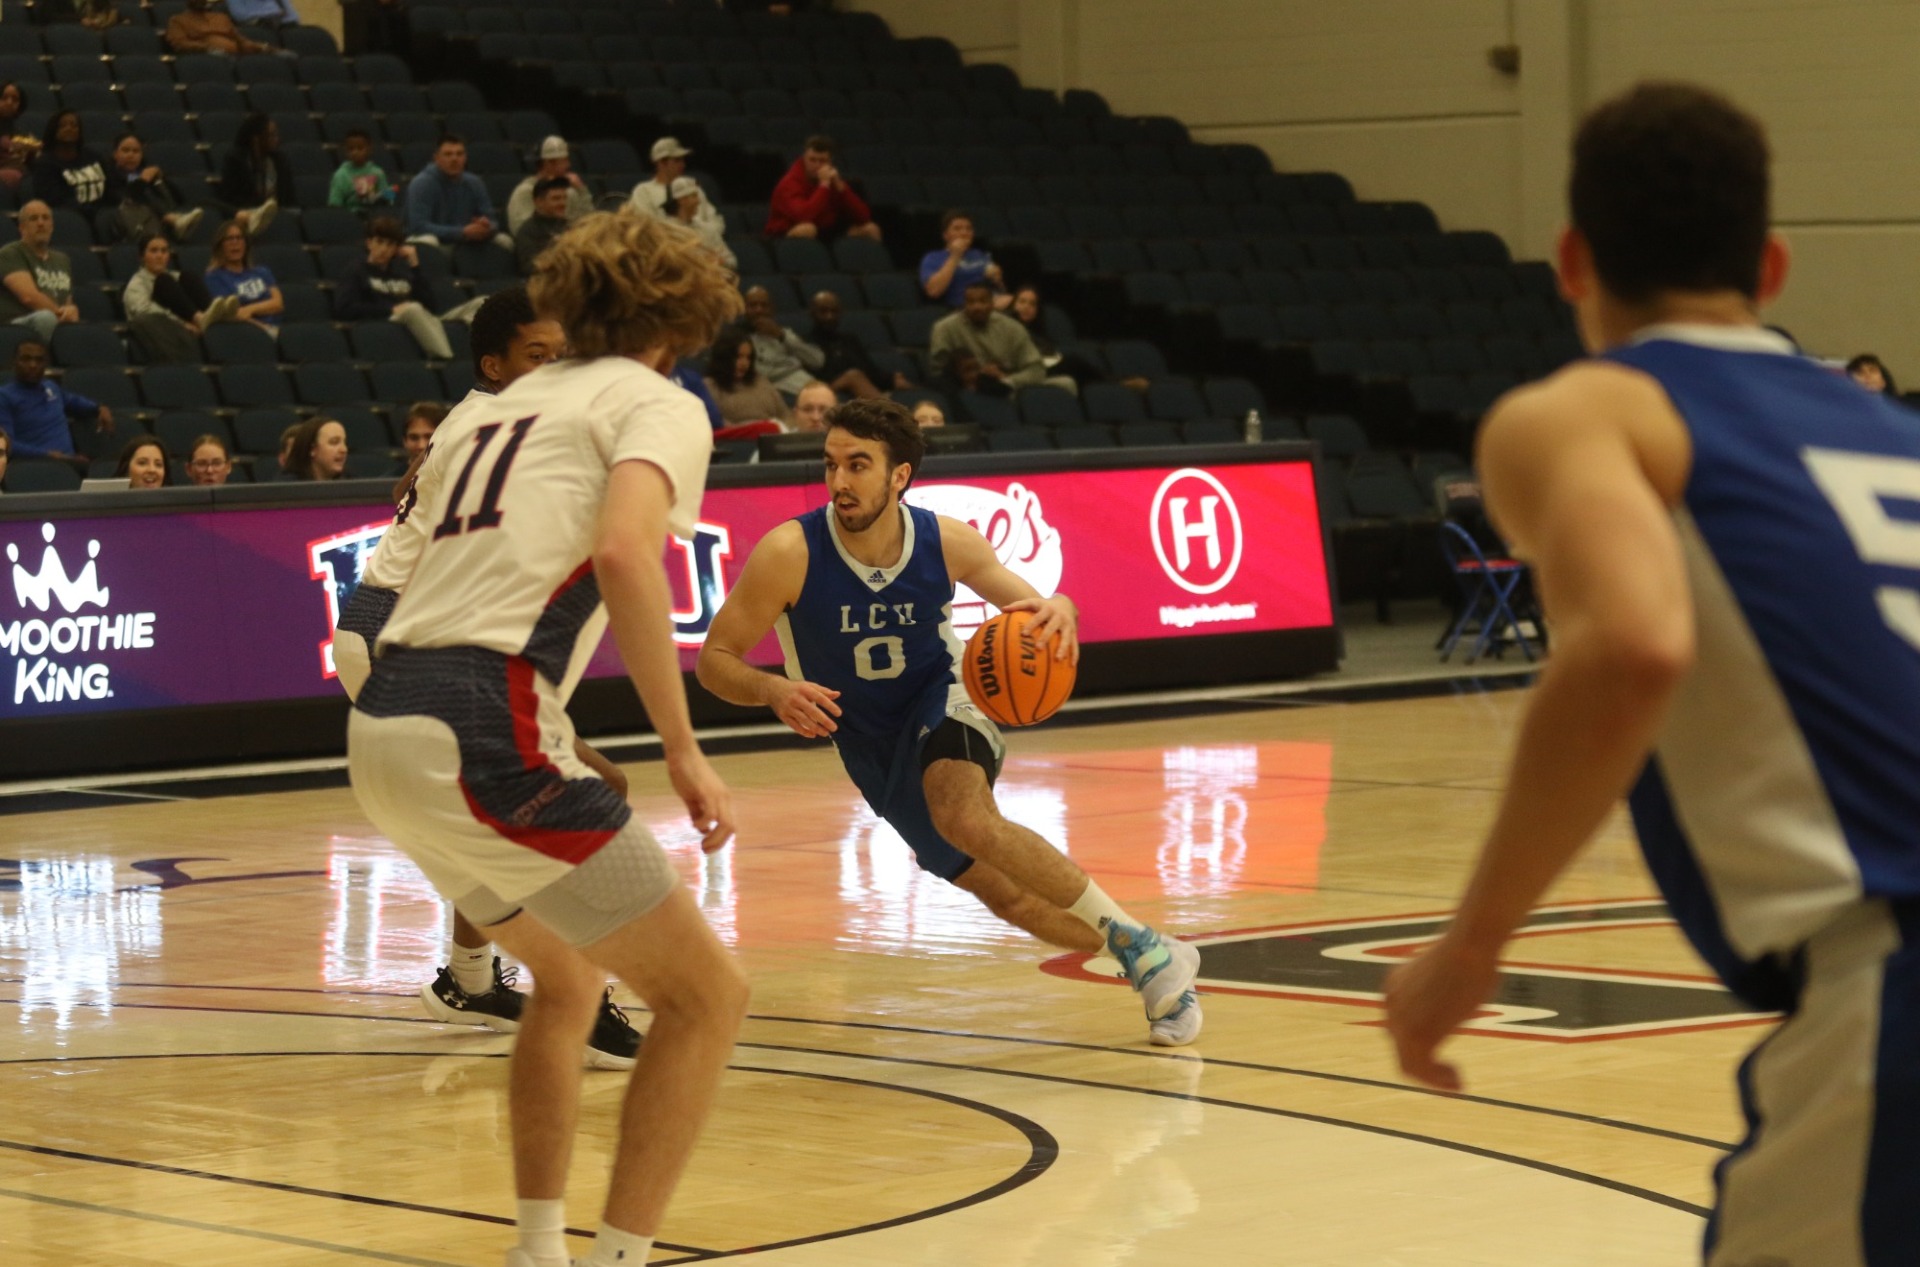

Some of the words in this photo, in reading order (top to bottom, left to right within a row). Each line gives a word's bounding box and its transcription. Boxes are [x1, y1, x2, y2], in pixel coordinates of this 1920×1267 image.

[432, 414, 541, 543] 11
[1169, 495, 1221, 572] H
[840, 602, 917, 633] LCU
[853, 635, 906, 681] 0
[977, 624, 1000, 697] Wilson
